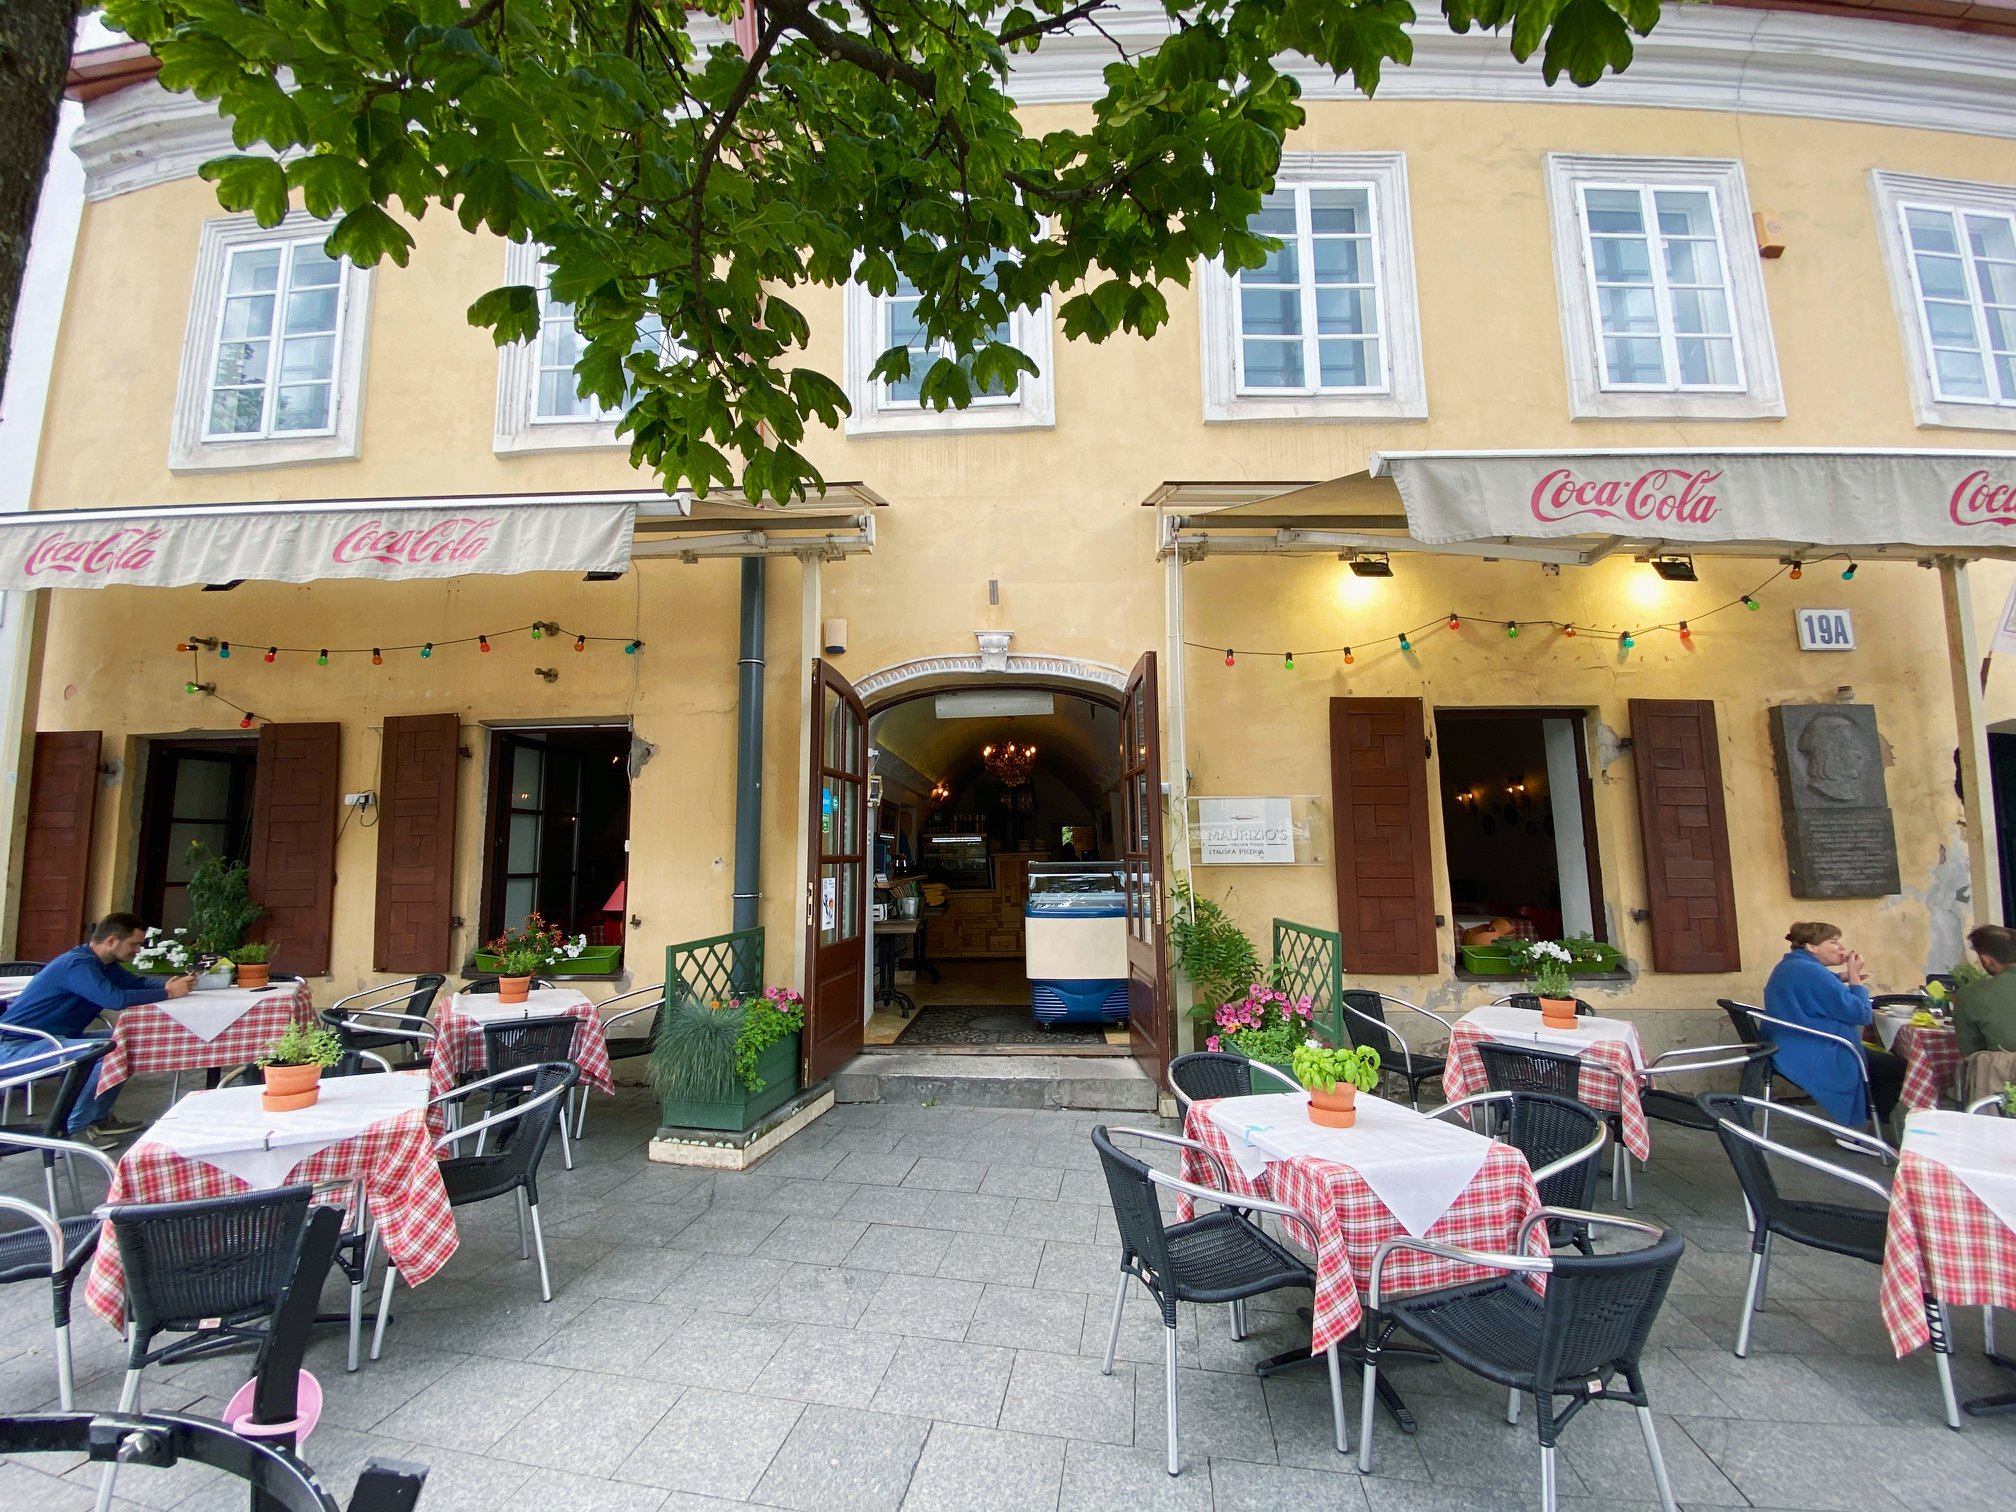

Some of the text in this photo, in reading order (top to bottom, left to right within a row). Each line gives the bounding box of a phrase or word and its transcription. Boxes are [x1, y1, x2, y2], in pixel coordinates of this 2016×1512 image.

[1530, 468, 1725, 524] Coca-Cola
[332, 517, 501, 565] Coca-Cola
[1804, 614, 1849, 645] 19A
[1207, 828, 1288, 841] MAURIZIO'S
